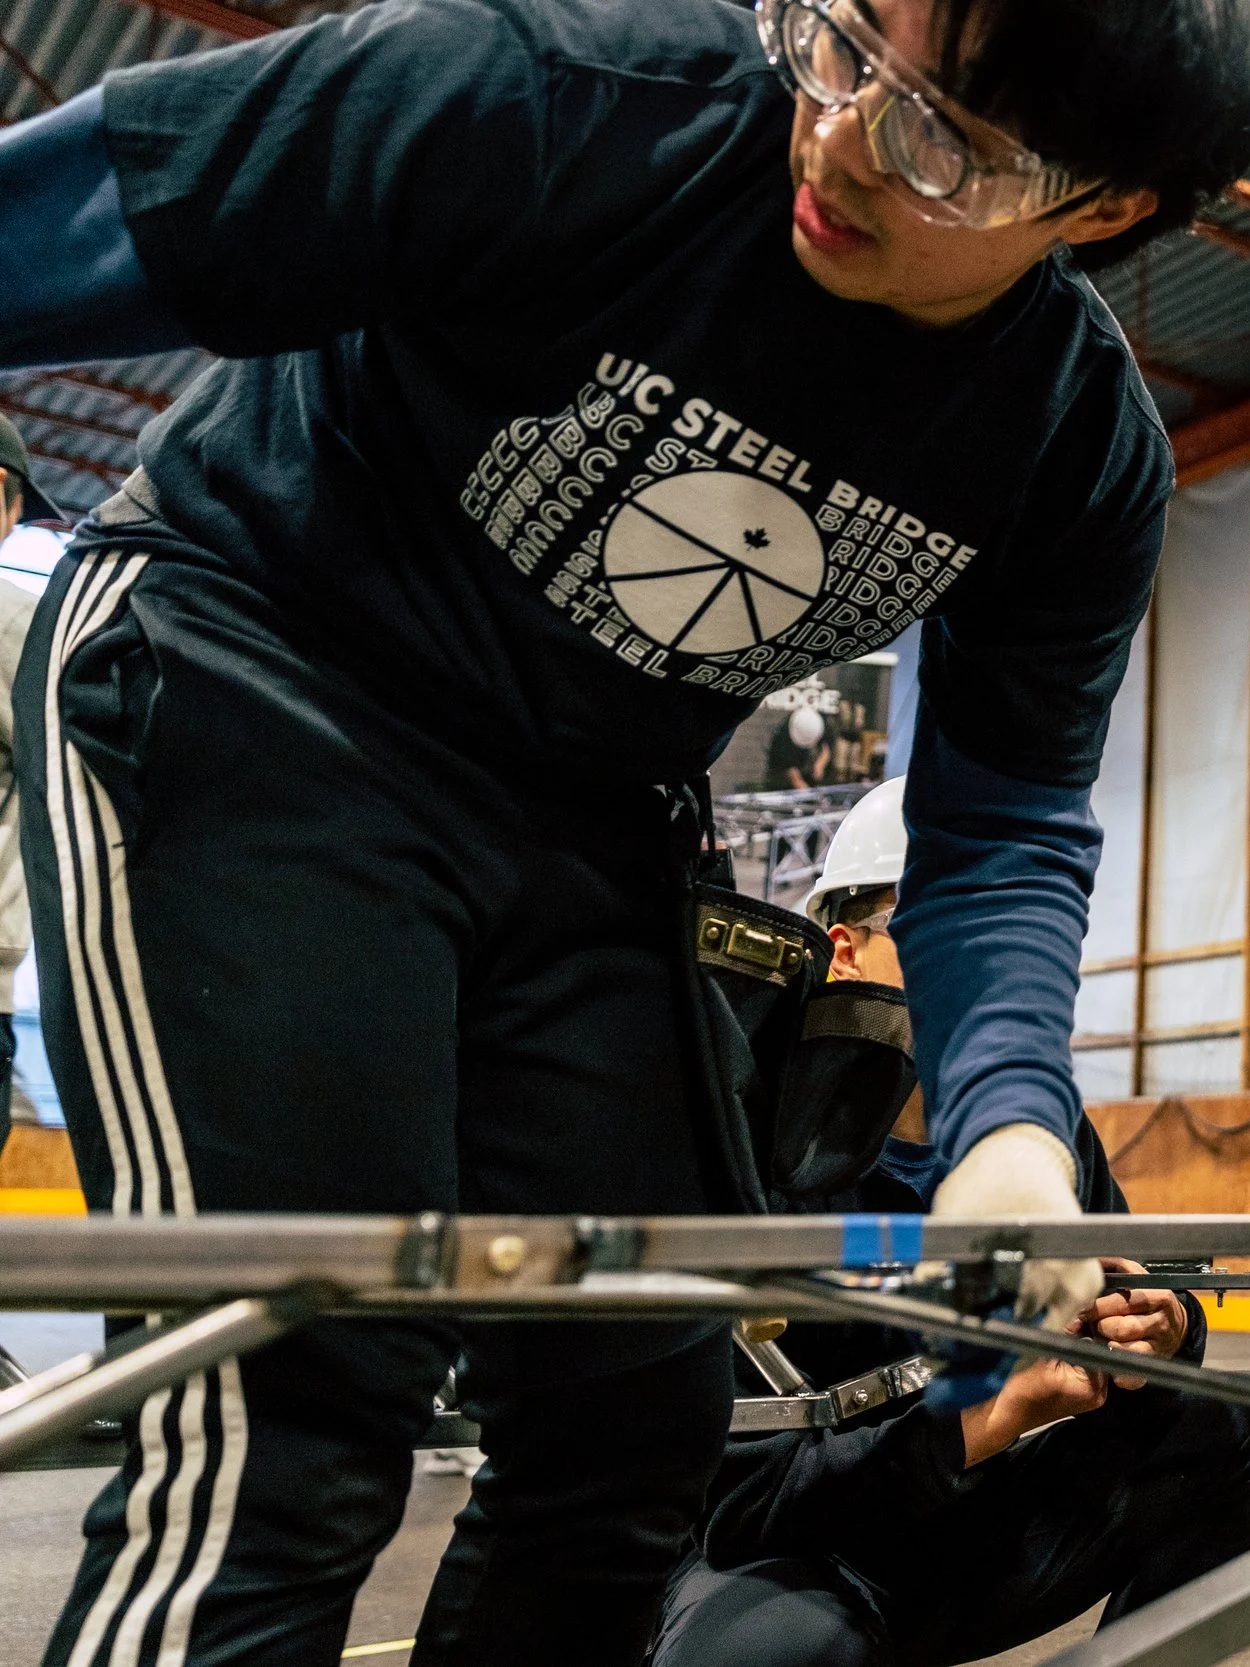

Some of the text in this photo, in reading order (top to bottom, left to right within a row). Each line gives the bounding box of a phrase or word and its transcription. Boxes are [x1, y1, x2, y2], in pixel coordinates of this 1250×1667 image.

[671, 398, 812, 493] STEEL
[826, 478, 979, 571] BRIDGE
[814, 503, 958, 594] BRIDGE
